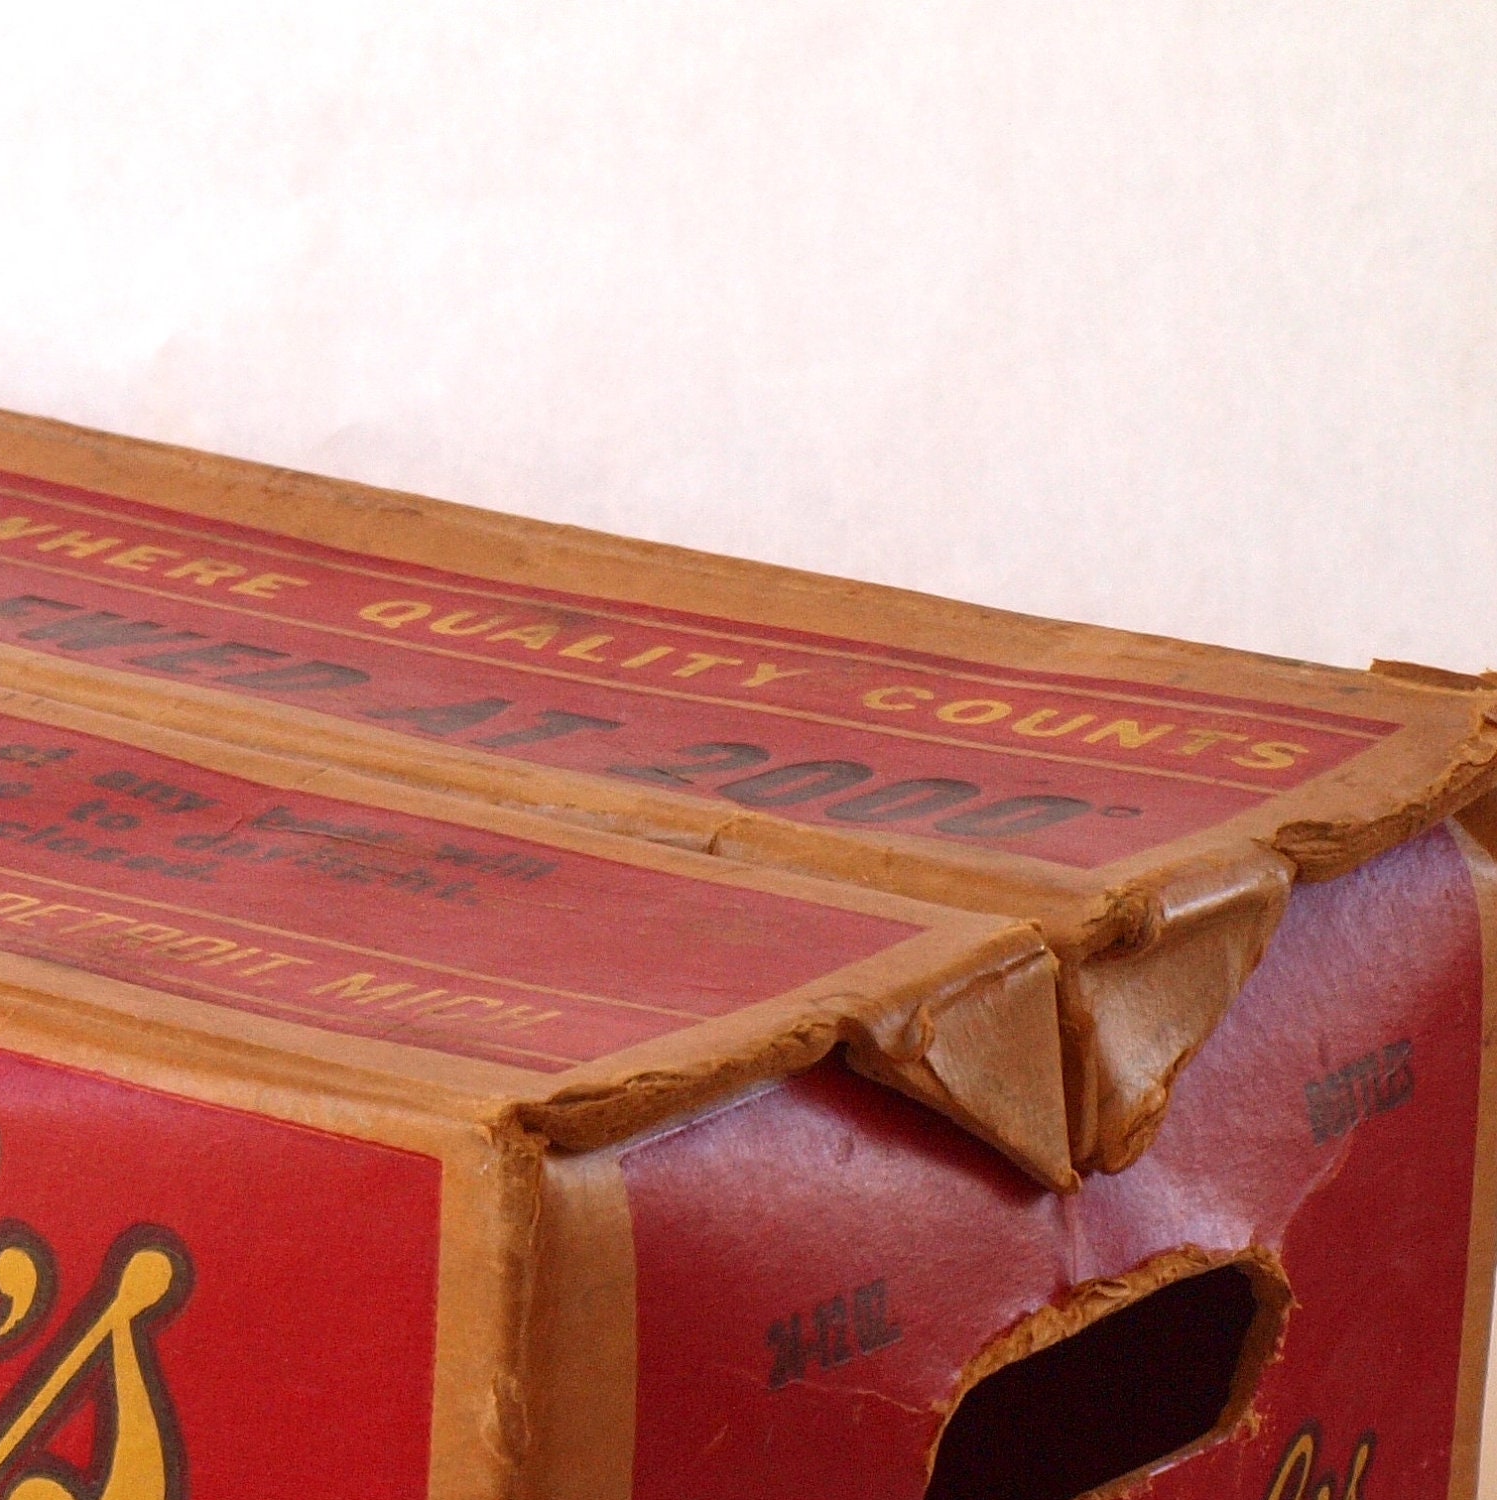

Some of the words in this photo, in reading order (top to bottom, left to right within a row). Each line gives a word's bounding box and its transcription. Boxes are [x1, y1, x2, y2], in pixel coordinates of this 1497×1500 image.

[357, 596, 811, 689] QUALITY
[862, 683, 1310, 772] COUNTS
[364, 697, 622, 750] AT
[67, 798, 142, 831] to
[91, 770, 220, 815] any
[435, 843, 561, 881] will
